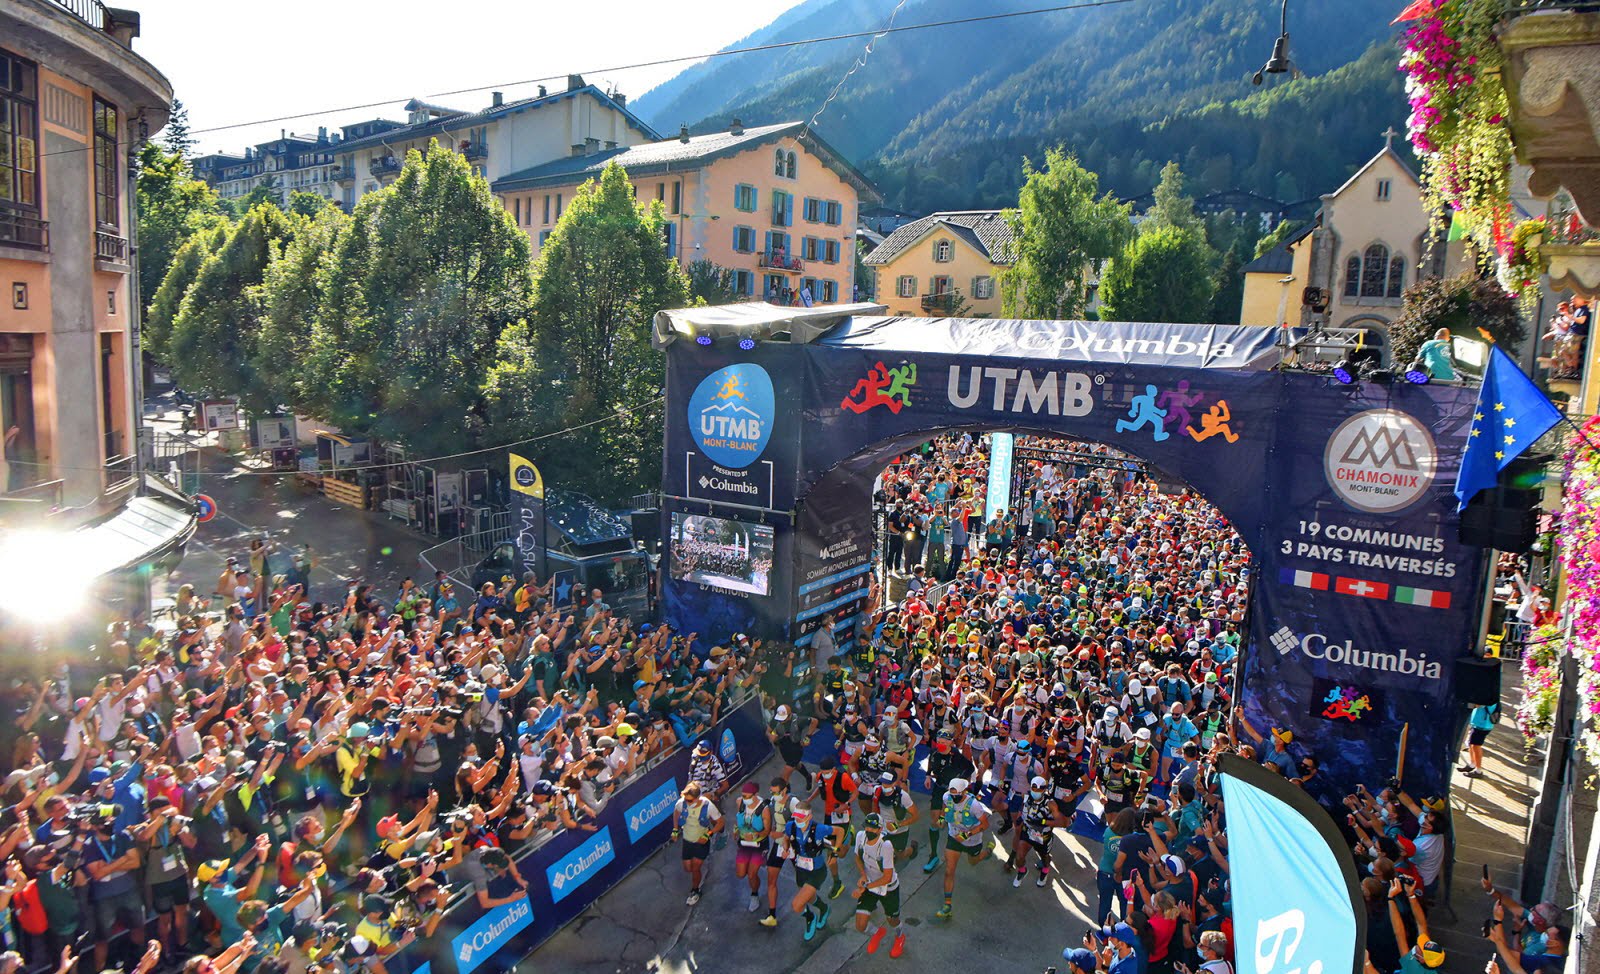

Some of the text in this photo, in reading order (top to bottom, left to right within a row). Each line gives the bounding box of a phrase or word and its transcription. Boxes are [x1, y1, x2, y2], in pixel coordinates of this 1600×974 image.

[1018, 330, 1234, 358] Columbia
[703, 438, 758, 451] MONT-BLANC
[709, 477, 758, 494] Columbia
[712, 465, 741, 477] PRESENTED
[1336, 467, 1419, 488] CHAMONIX
[1349, 484, 1399, 496] MONT-BLANC
[1299, 520, 1445, 553] 19 COMMUNES
[1281, 540, 1456, 578] 3 PAYS TRAVERSÉS
[1301, 633, 1442, 679] Columbia
[639, 789, 678, 824] Columbia
[565, 840, 611, 880] Columbia
[472, 902, 528, 951] Columbia
